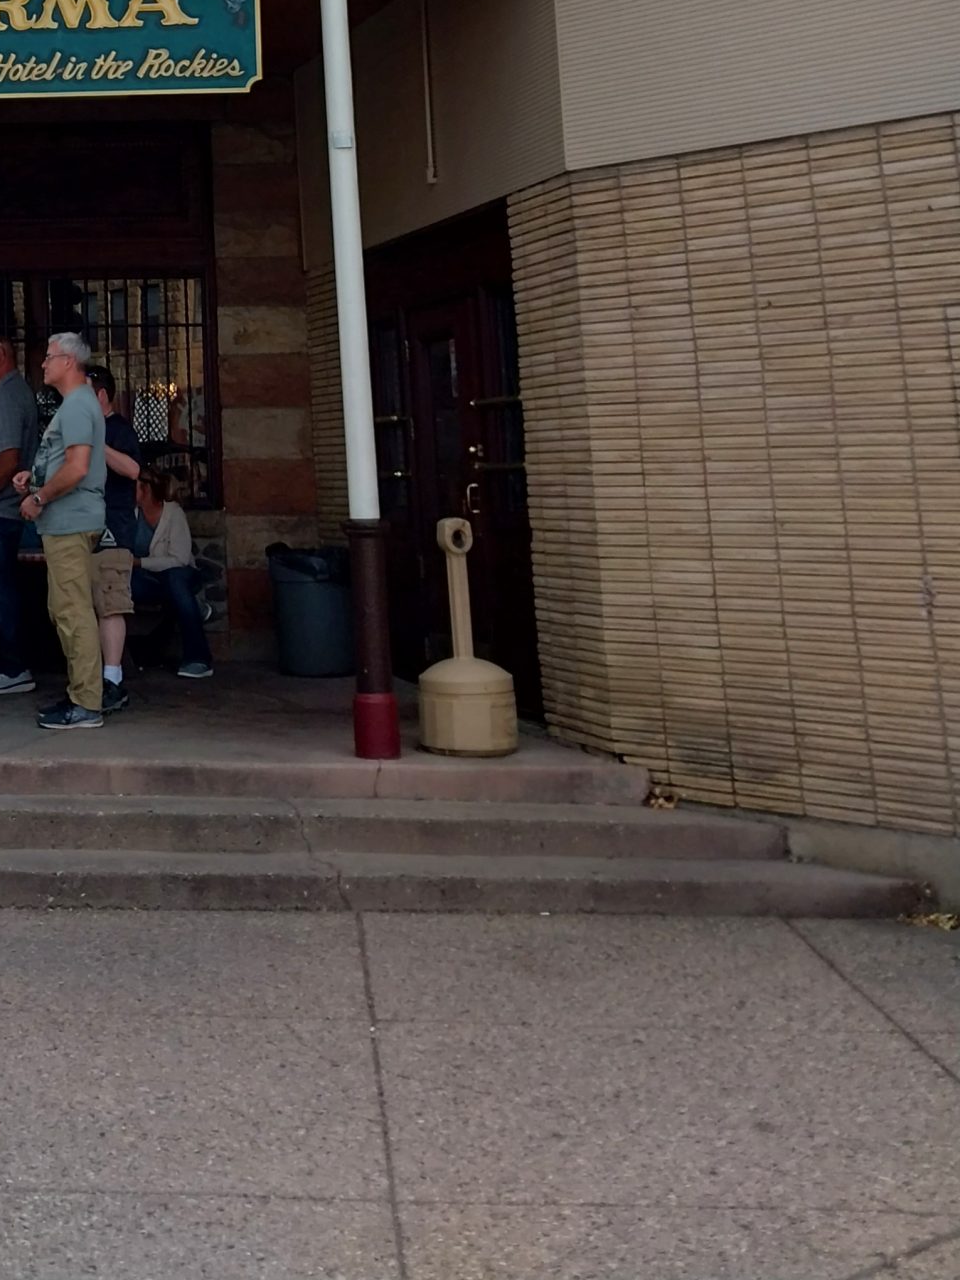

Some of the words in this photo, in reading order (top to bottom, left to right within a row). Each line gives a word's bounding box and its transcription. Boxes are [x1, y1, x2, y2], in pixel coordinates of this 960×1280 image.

[62, 56, 88, 81] in
[91, 50, 134, 80] the
[137, 48, 246, 79] Rockies
